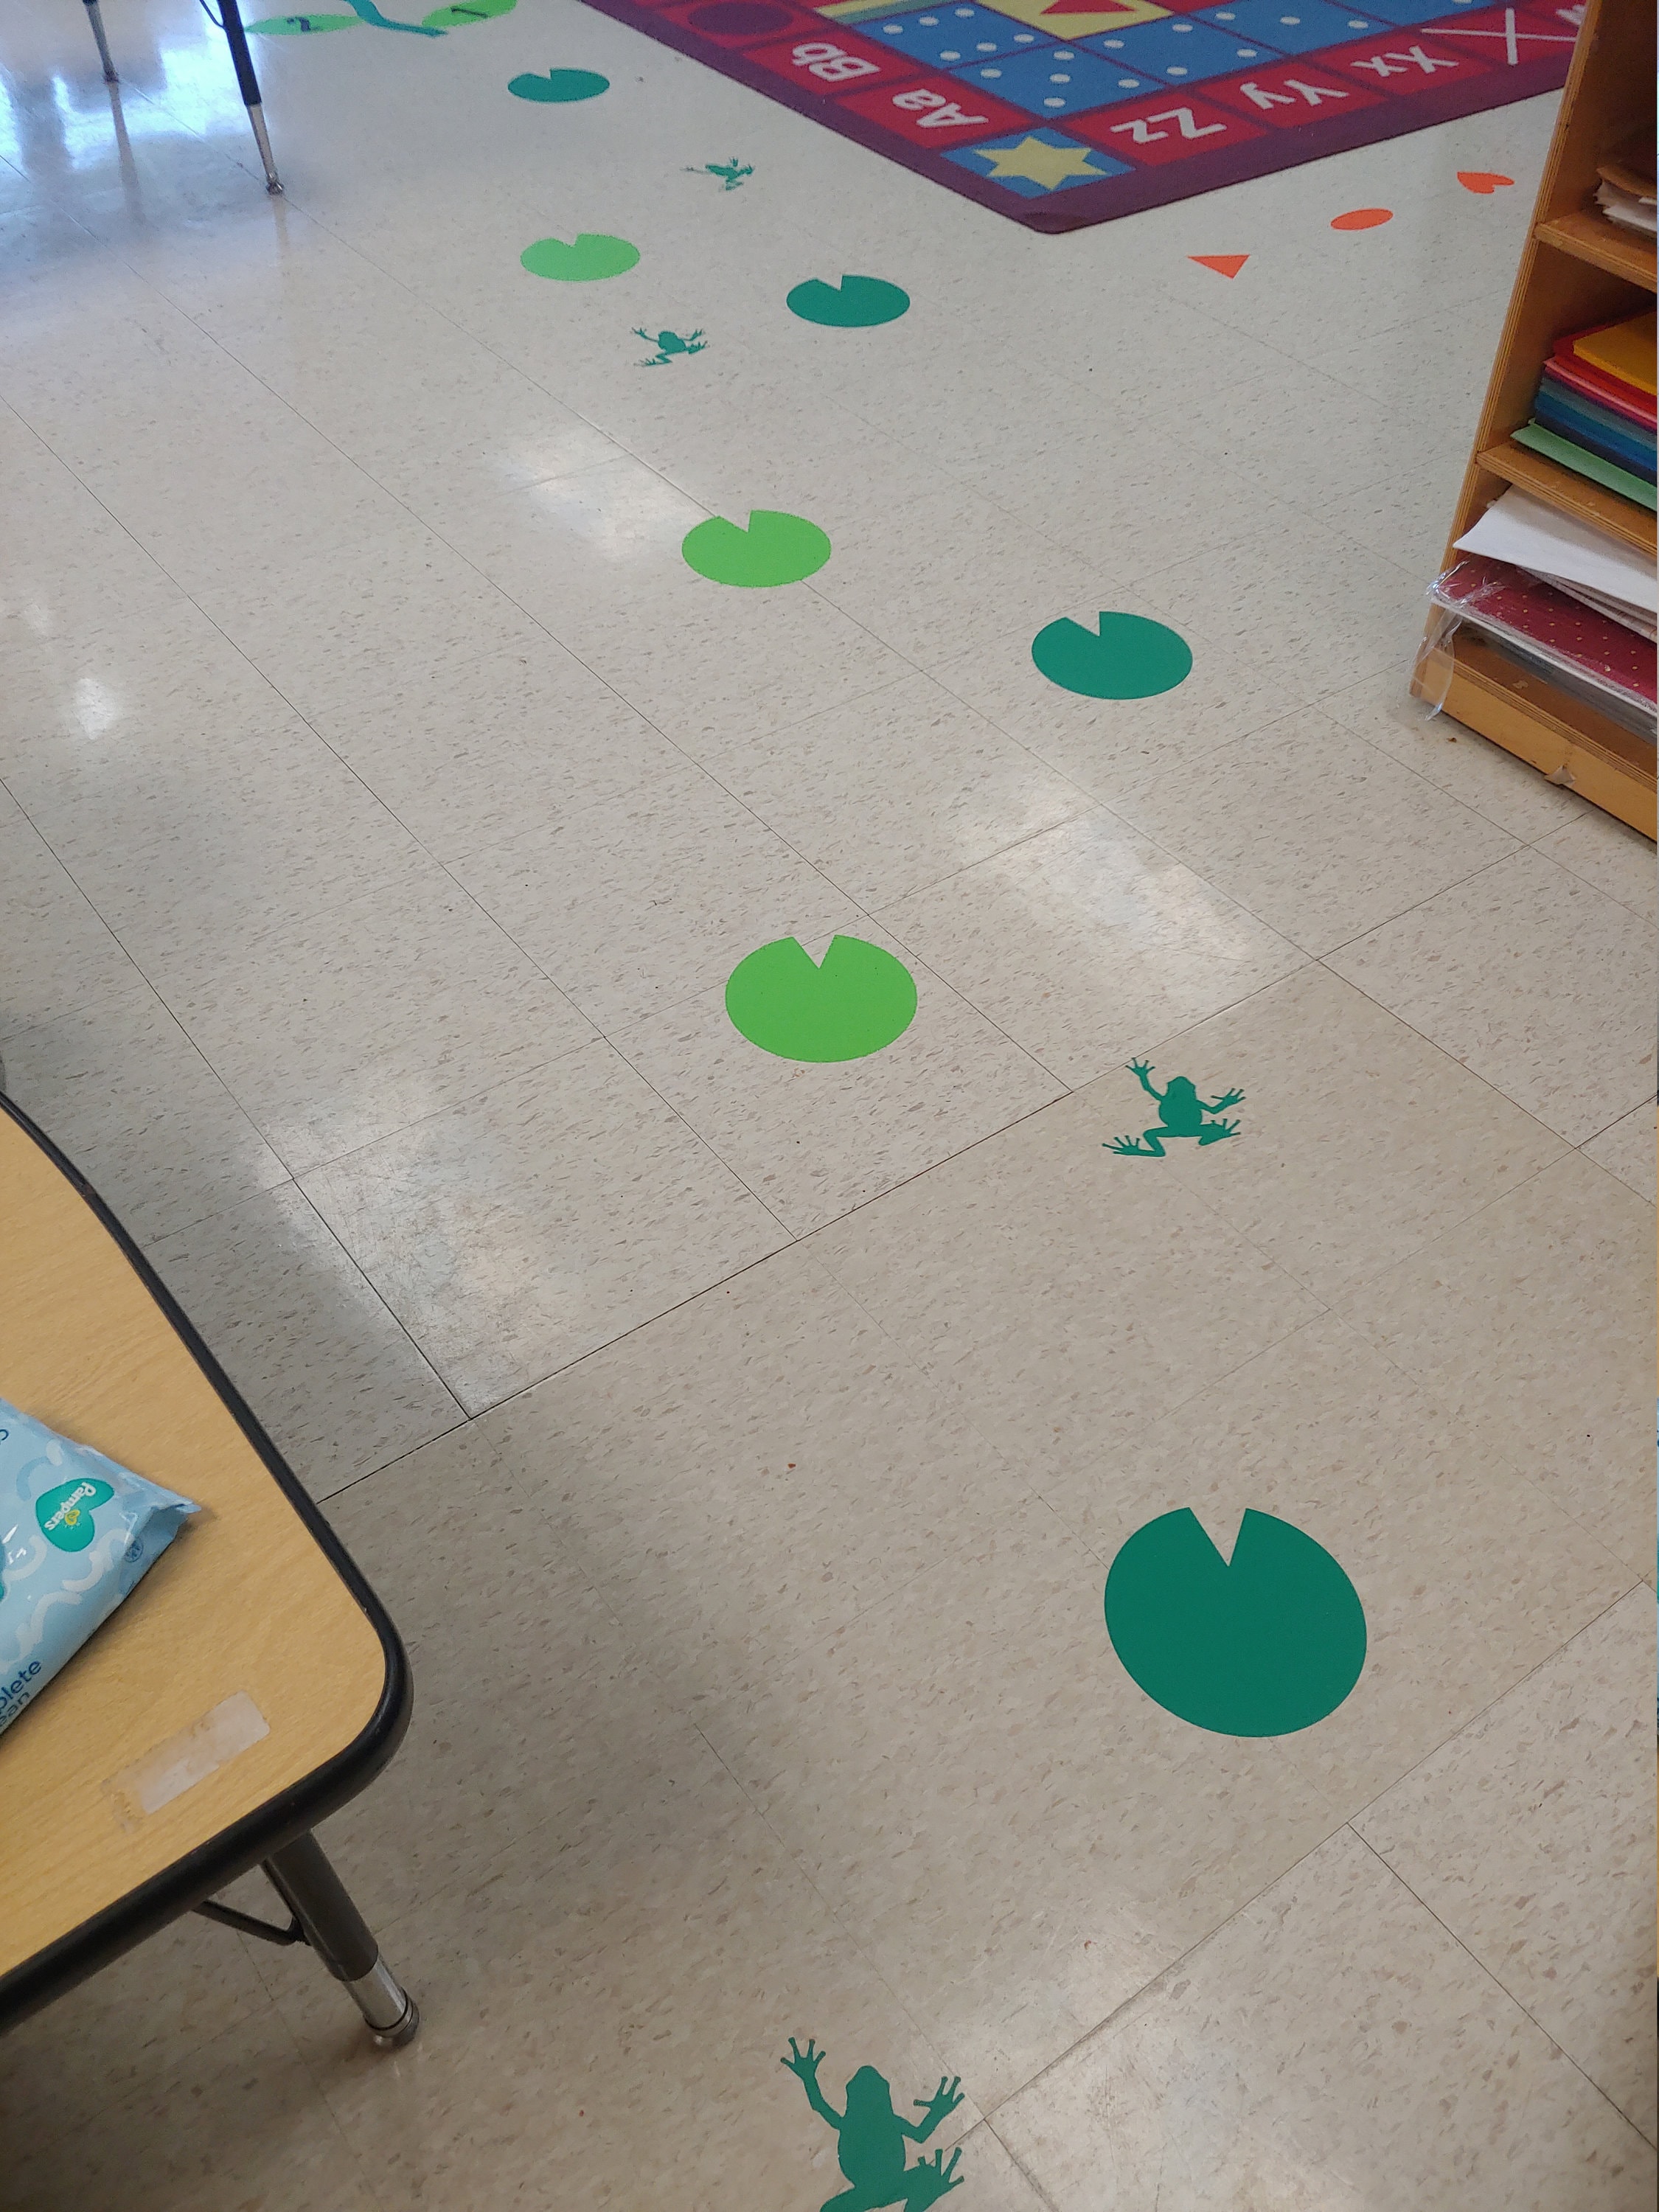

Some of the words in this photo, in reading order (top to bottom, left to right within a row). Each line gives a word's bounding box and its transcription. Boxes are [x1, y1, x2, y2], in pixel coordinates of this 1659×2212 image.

[792, 42, 880, 81] Bb
[1351, 46, 1458, 77] Xx
[892, 88, 988, 128] Aa
[1239, 80, 1349, 109] Yy
[1110, 107, 1226, 144] Zz
[44, 1482, 96, 1530] Pampers
